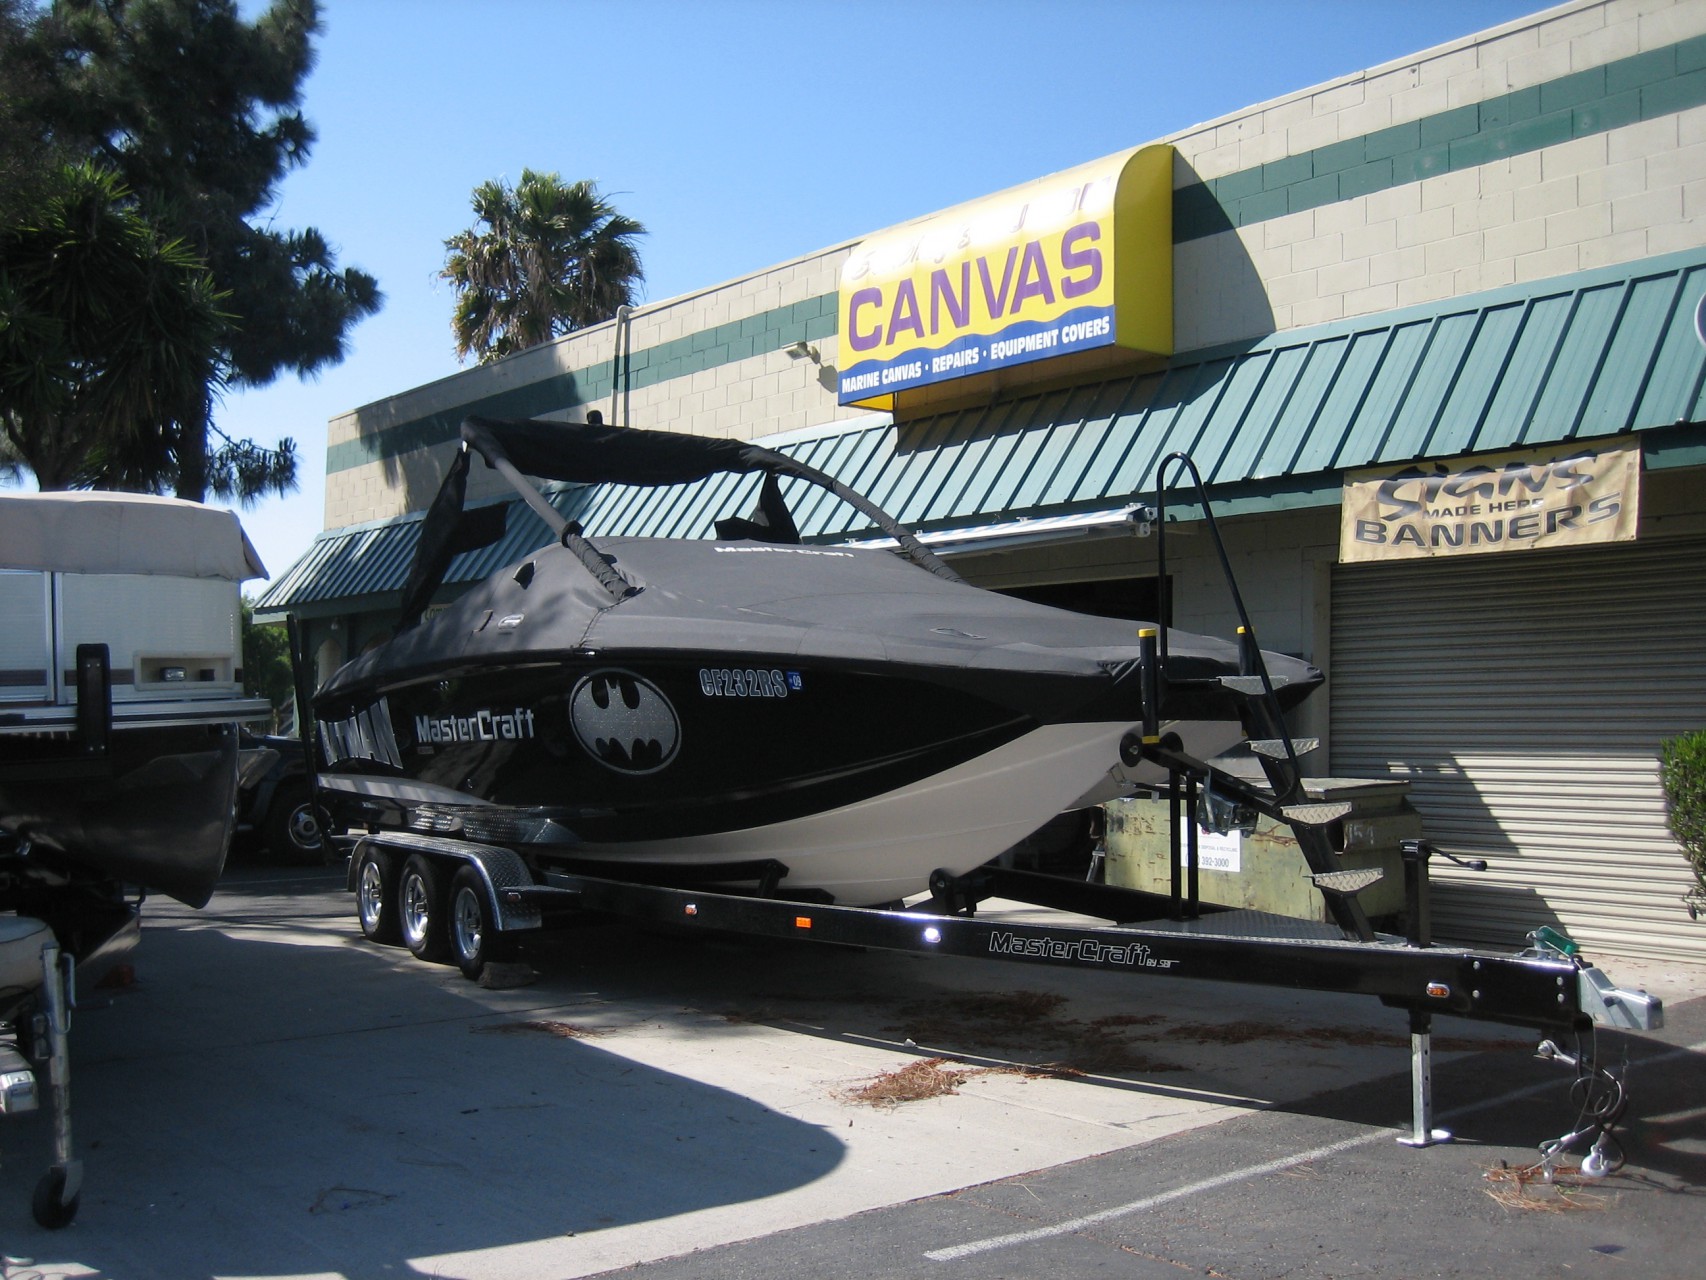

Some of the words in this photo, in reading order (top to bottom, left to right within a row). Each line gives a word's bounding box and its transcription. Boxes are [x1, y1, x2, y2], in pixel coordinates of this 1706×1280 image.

[848, 221, 1103, 352] CANVAS
[842, 370, 880, 394] MARINE
[881, 361, 923, 385] CANVAS
[932, 347, 980, 374] REPAIRS
[990, 328, 1059, 360] EQUIPMENT
[1061, 316, 1111, 344] COVERS
[1354, 491, 1624, 549] BANNERS
[1422, 504, 1482, 520] MADE
[1488, 497, 1545, 514] HERE
[699, 668, 788, 698] CF232RS
[415, 707, 535, 743] MasterCraft
[988, 931, 1151, 966] MasterCraft
